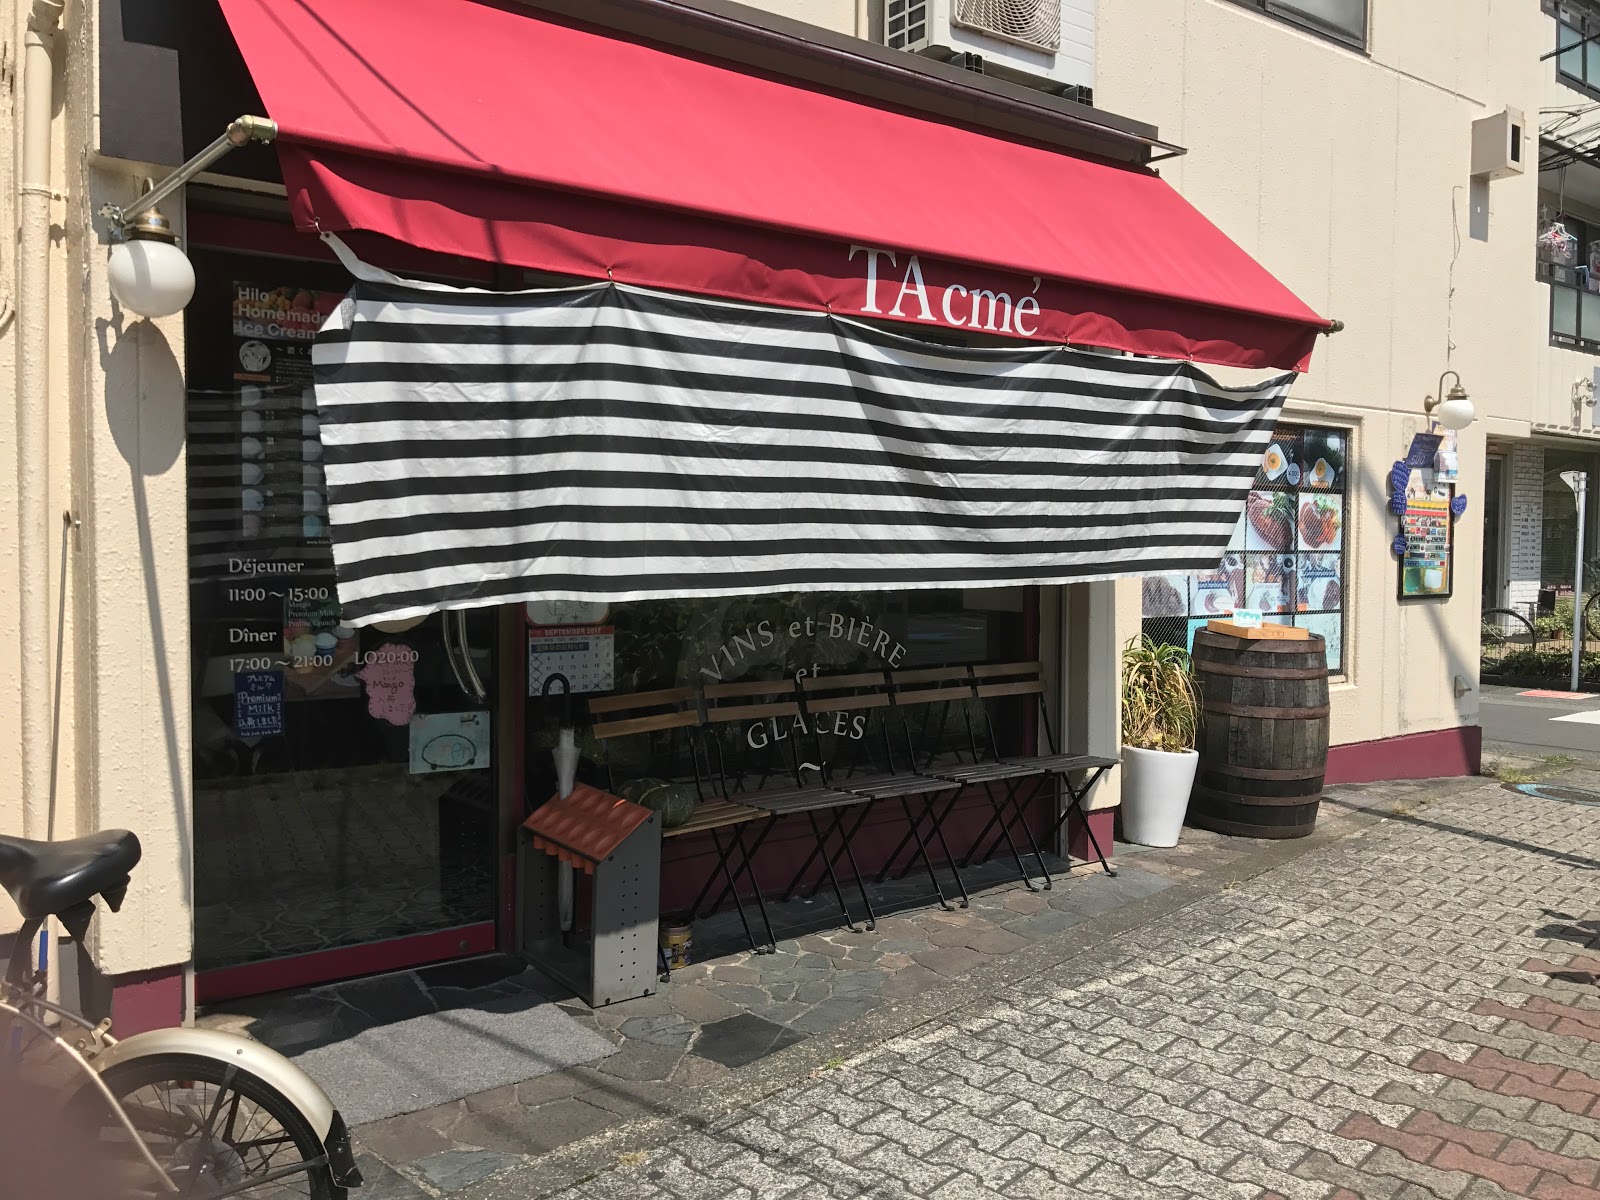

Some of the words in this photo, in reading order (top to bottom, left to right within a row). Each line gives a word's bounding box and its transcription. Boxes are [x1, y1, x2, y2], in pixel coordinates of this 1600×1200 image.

[238, 287, 270, 302] Hilo
[239, 320, 264, 335] Ice
[228, 558, 304, 578] Déjeuner
[229, 588, 266, 601] 11:00
[288, 588, 328, 602] 15:00
[288, 610, 318, 618] Premium
[229, 628, 276, 643] Dîner
[700, 619, 774, 681] VINS
[788, 616, 815, 638] et
[829, 613, 907, 669] BIÈRE
[229, 658, 271, 673] 17:00
[293, 654, 333, 668] 21:00
[796, 662, 820, 684] et
[373, 680, 404, 694] Mango
[242, 692, 278, 704] Premium
[249, 704, 274, 713] Milk
[747, 712, 866, 749] GLACES
